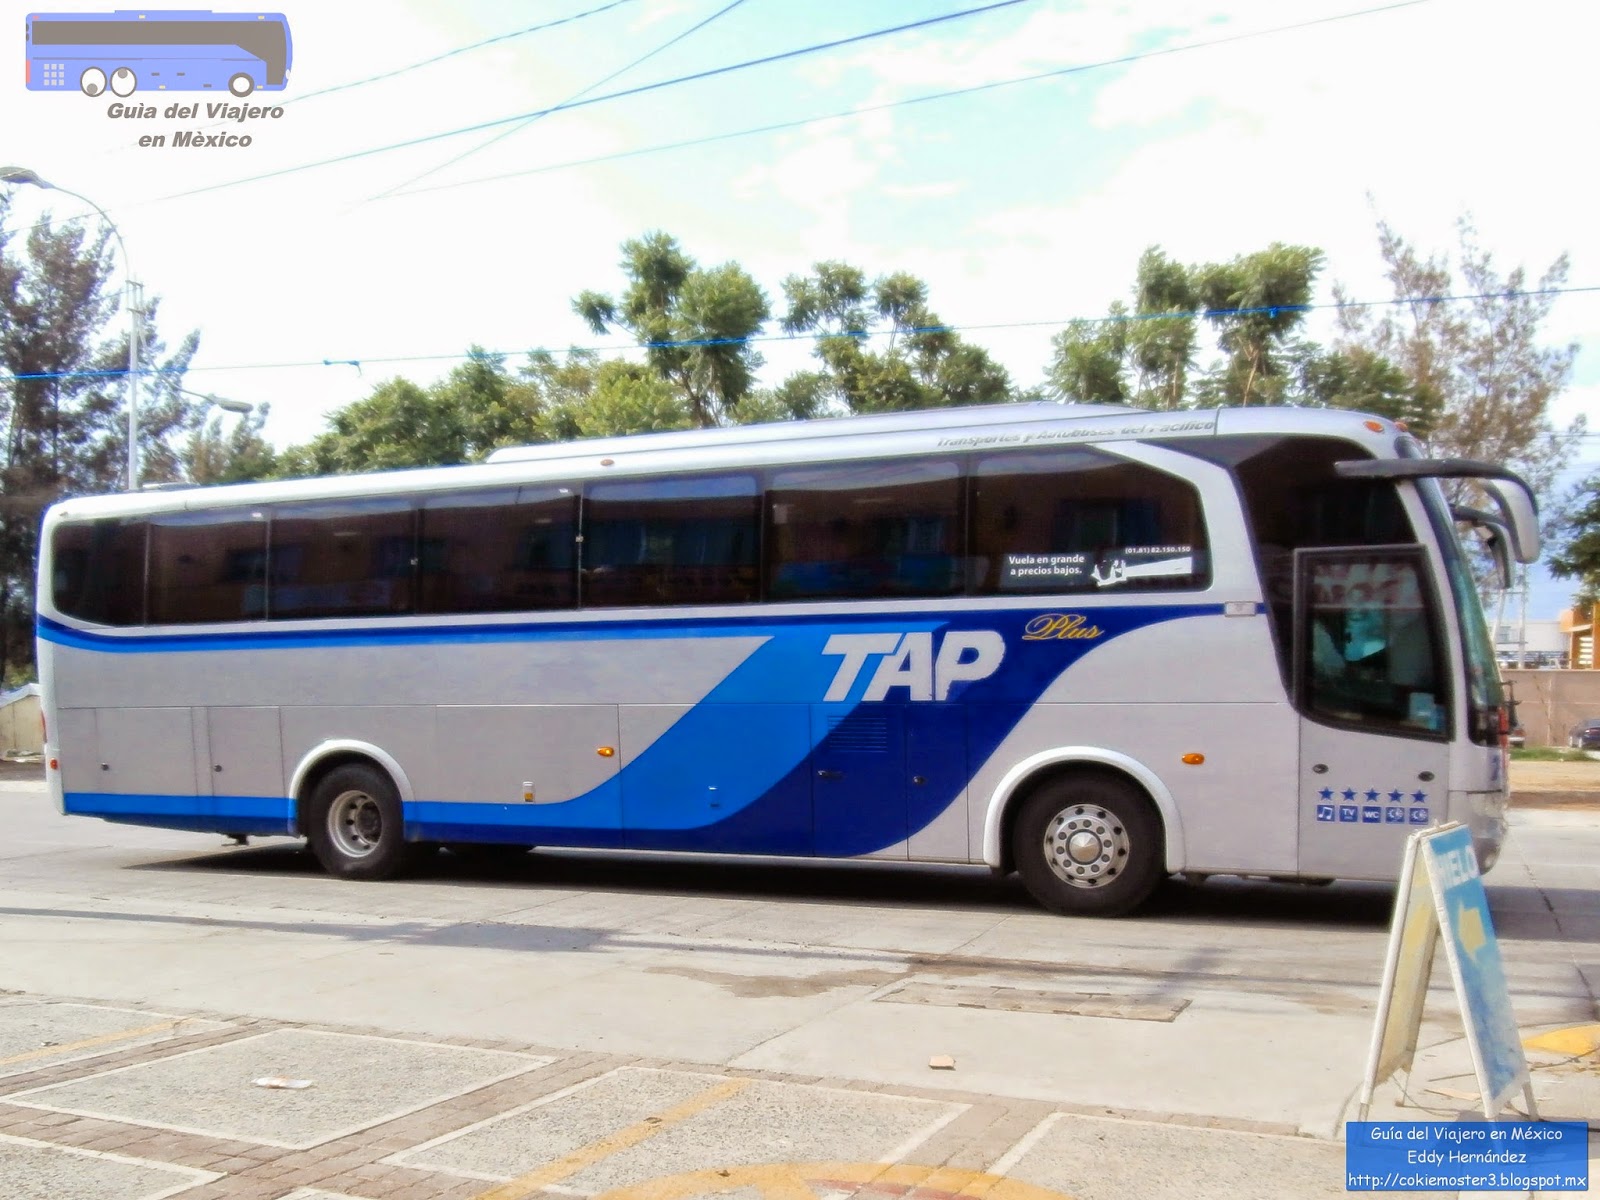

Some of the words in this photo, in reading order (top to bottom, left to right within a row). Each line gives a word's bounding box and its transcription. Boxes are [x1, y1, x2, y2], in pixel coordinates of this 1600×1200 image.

[1009, 556, 1035, 565] Vuela
[1051, 554, 1085, 566] grande
[1018, 566, 1052, 576] precios
[1054, 564, 1082, 575] bajos.
[1022, 614, 1104, 640] Plus
[821, 630, 1006, 701] TAP
[1342, 808, 1356, 816] TV
[1364, 811, 1379, 819] WC
